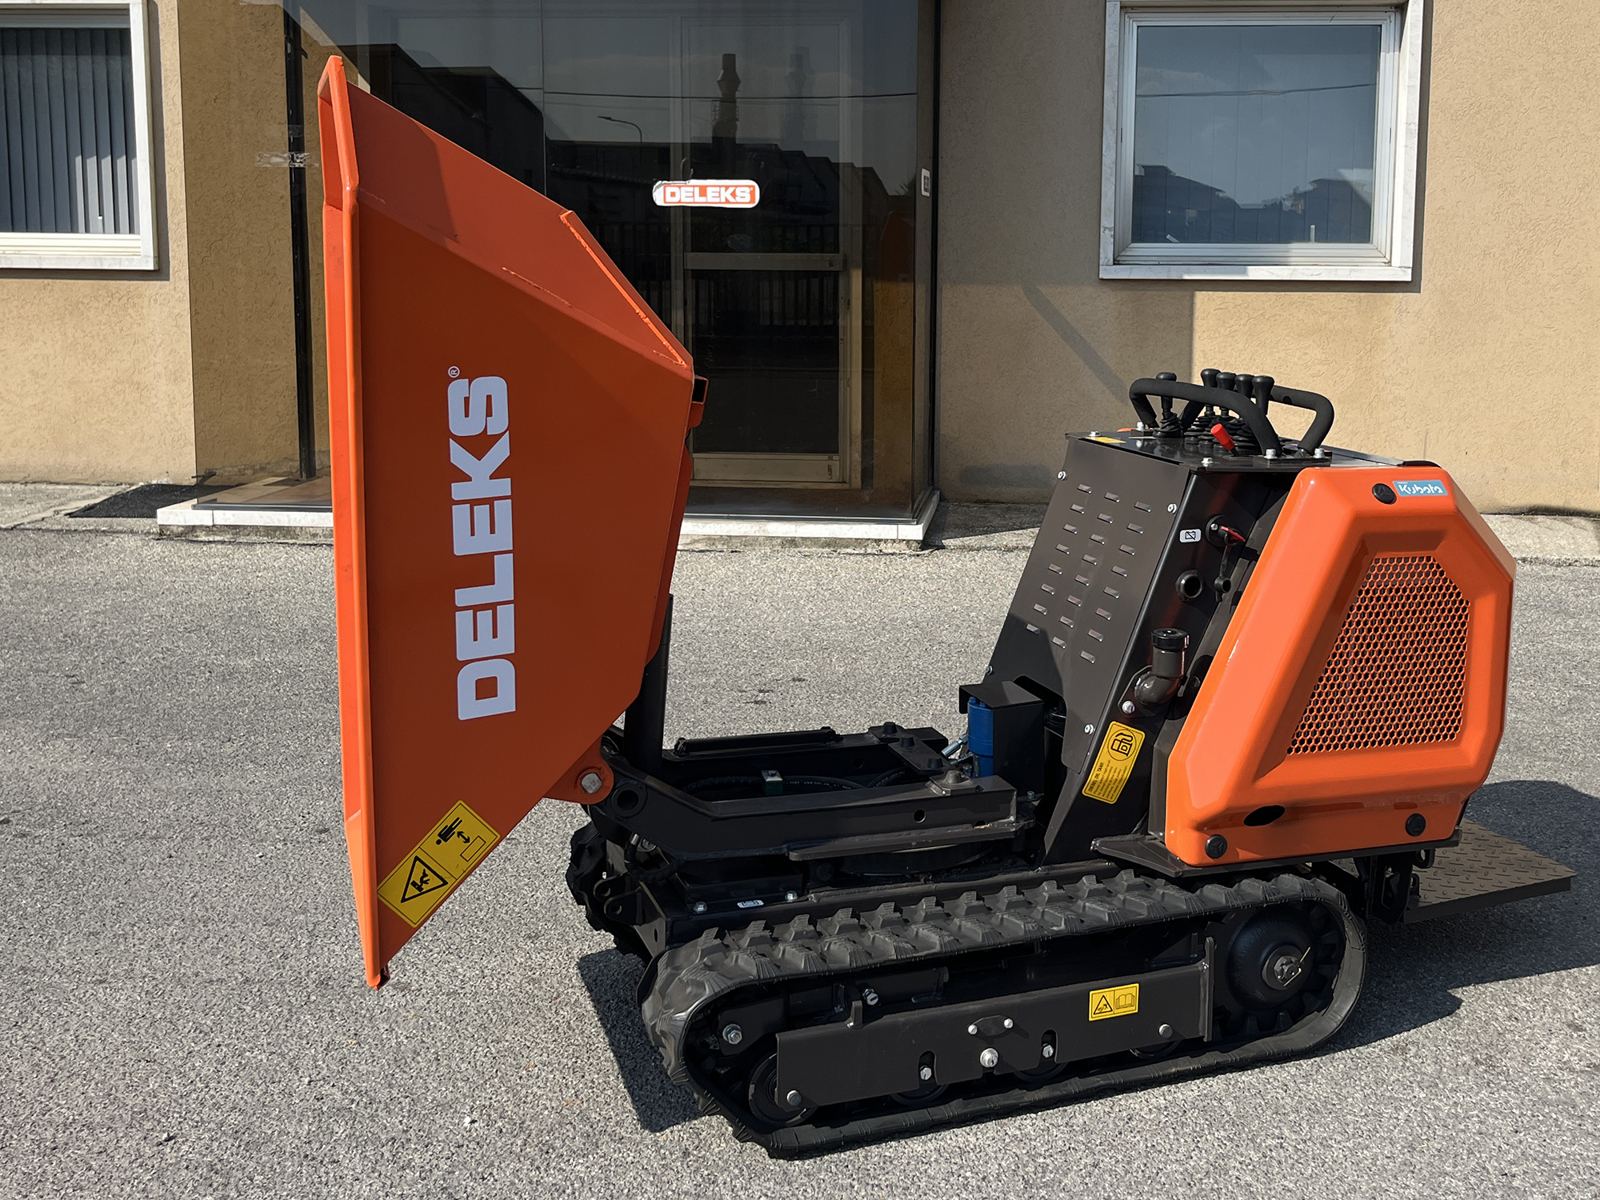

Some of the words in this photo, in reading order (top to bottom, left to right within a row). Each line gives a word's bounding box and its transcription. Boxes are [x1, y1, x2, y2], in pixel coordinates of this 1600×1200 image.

[665, 186, 751, 203] DELEKS
[1398, 483, 1444, 495] Kubota
[447, 375, 516, 721] DELEKS
